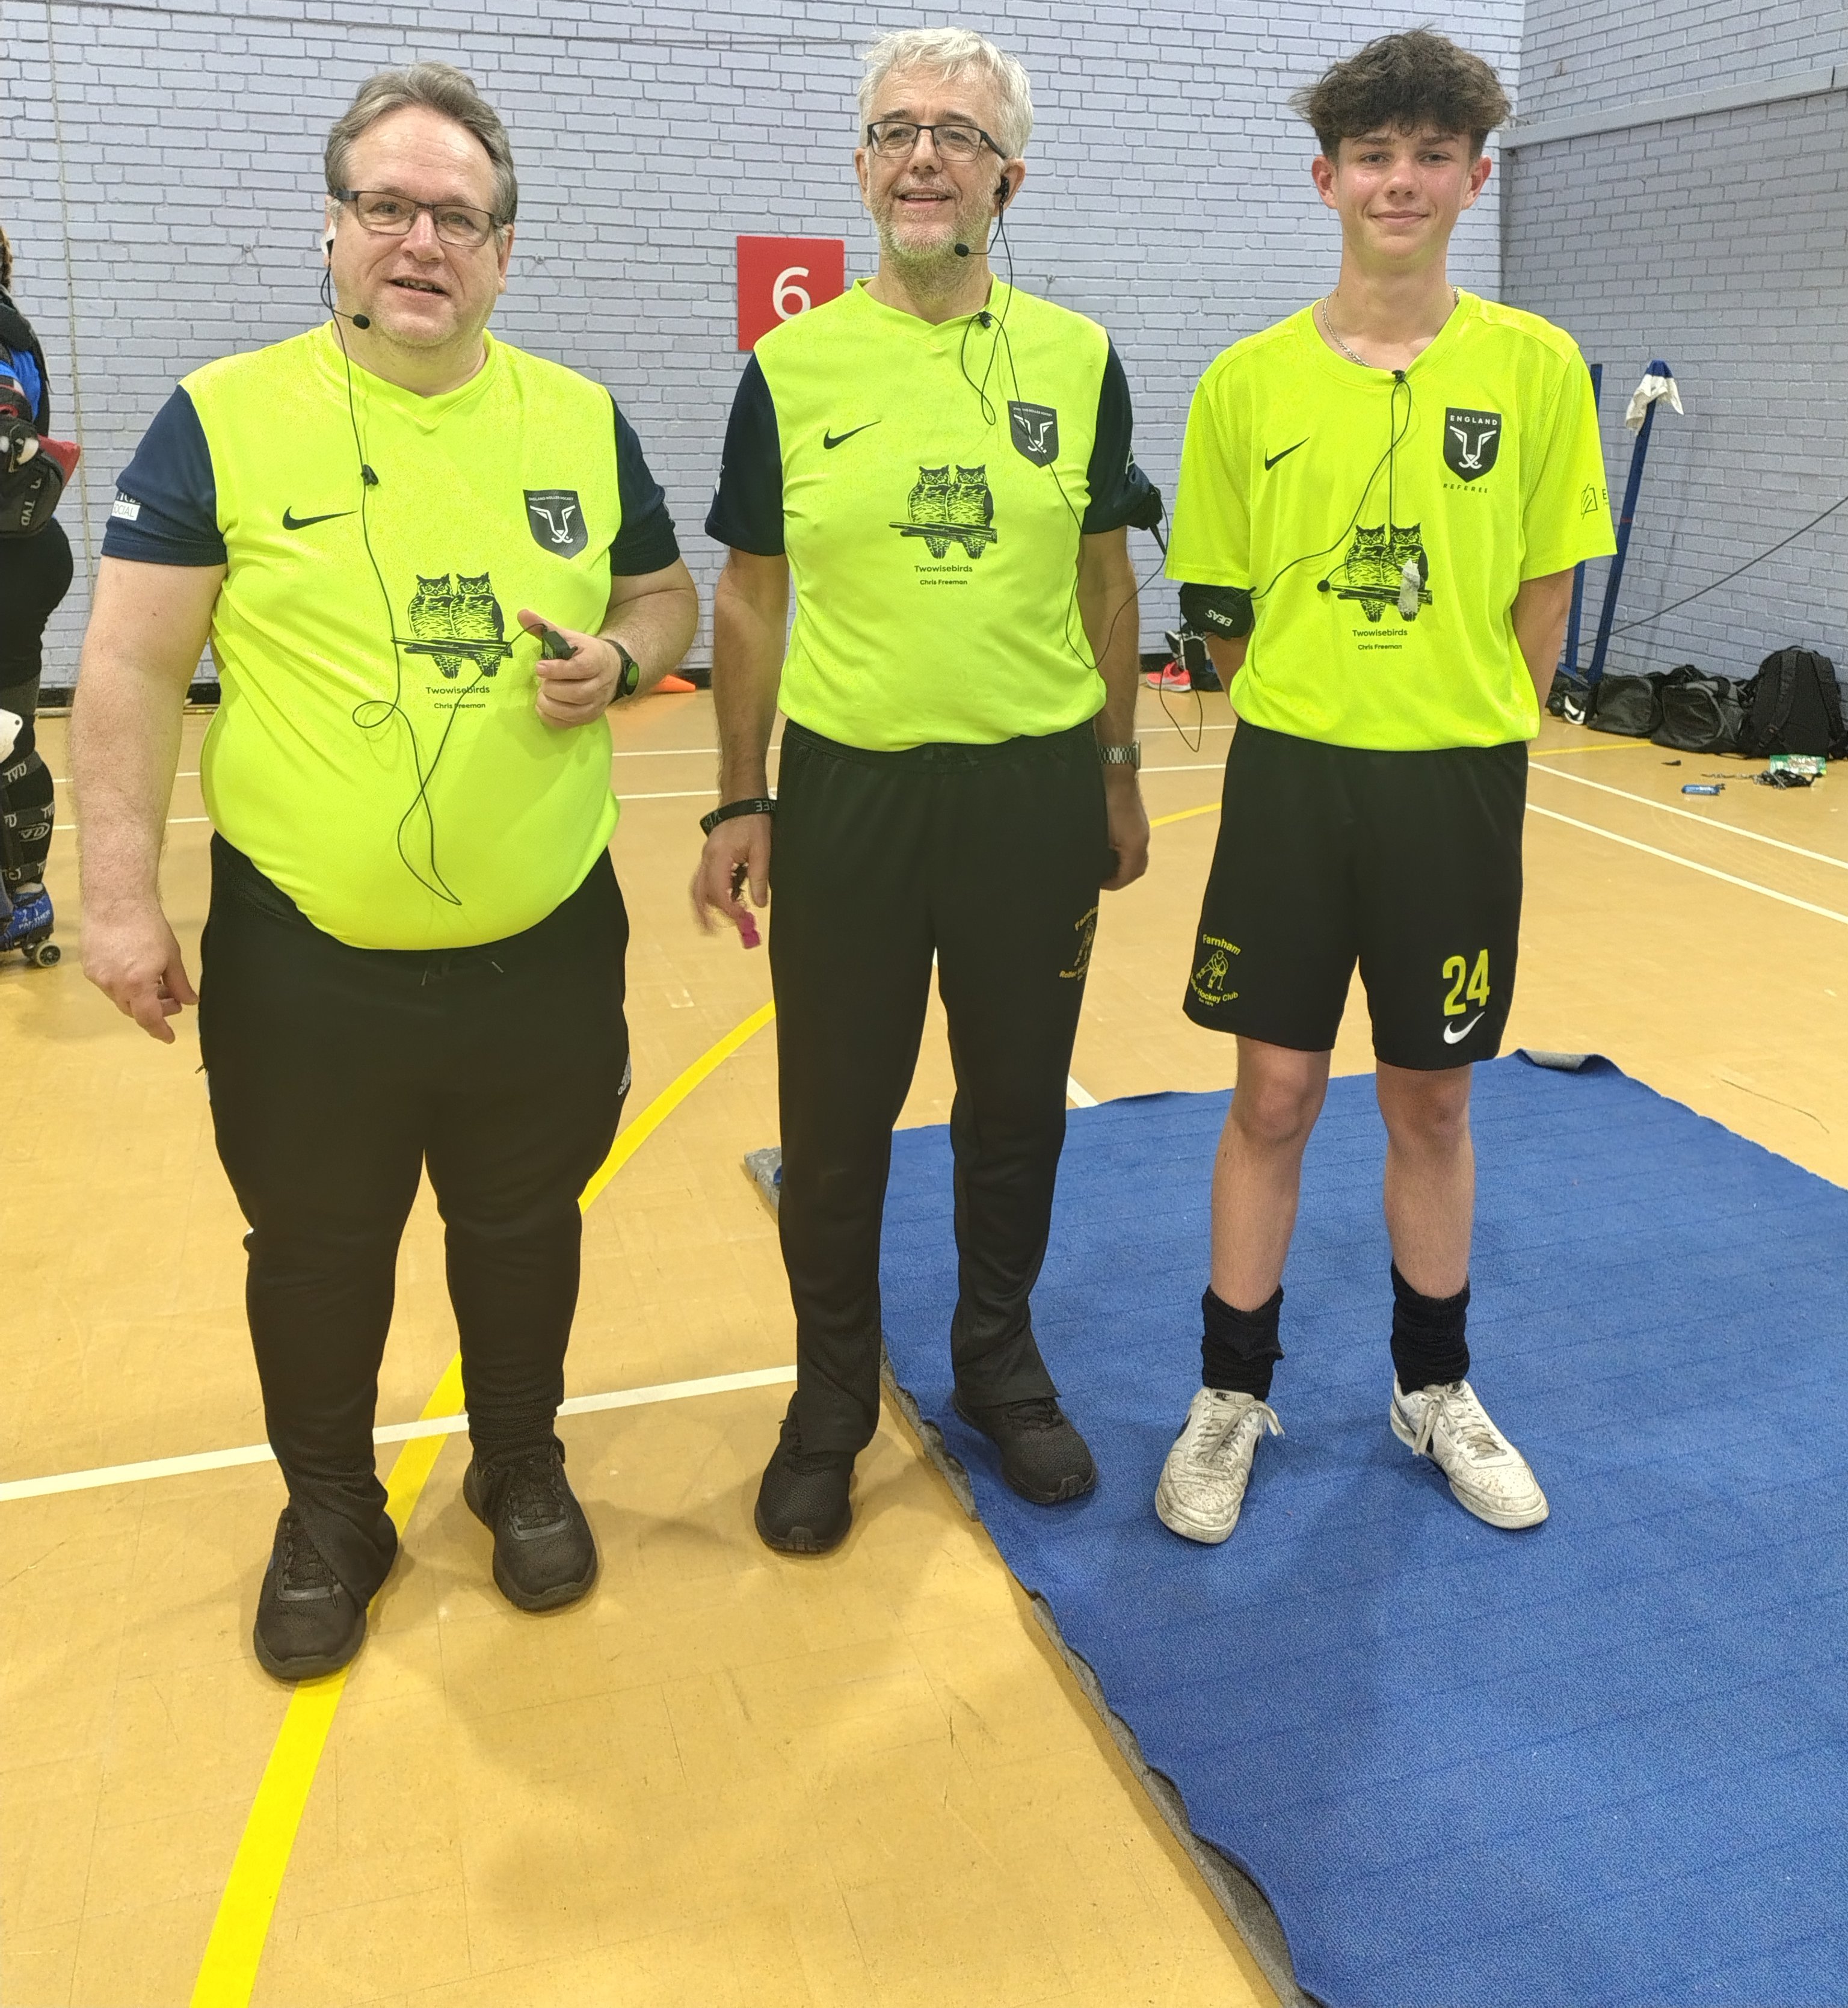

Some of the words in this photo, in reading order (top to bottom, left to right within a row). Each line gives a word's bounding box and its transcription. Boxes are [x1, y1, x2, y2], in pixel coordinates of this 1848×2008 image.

[772, 266, 811, 321] 6
[1450, 415, 1497, 425] ENGLAND
[1443, 484, 1488, 493] REFEREE
[1352, 629, 1408, 637] Twowisebirds
[425, 686, 490, 694] Twowisebirds
[2, 761, 27, 782] TVD
[1203, 934, 1241, 955] Farnham
[1443, 949, 1491, 1017] 24
[1197, 988, 1221, 1003] Hockey
[1222, 991, 1239, 1002] Club
